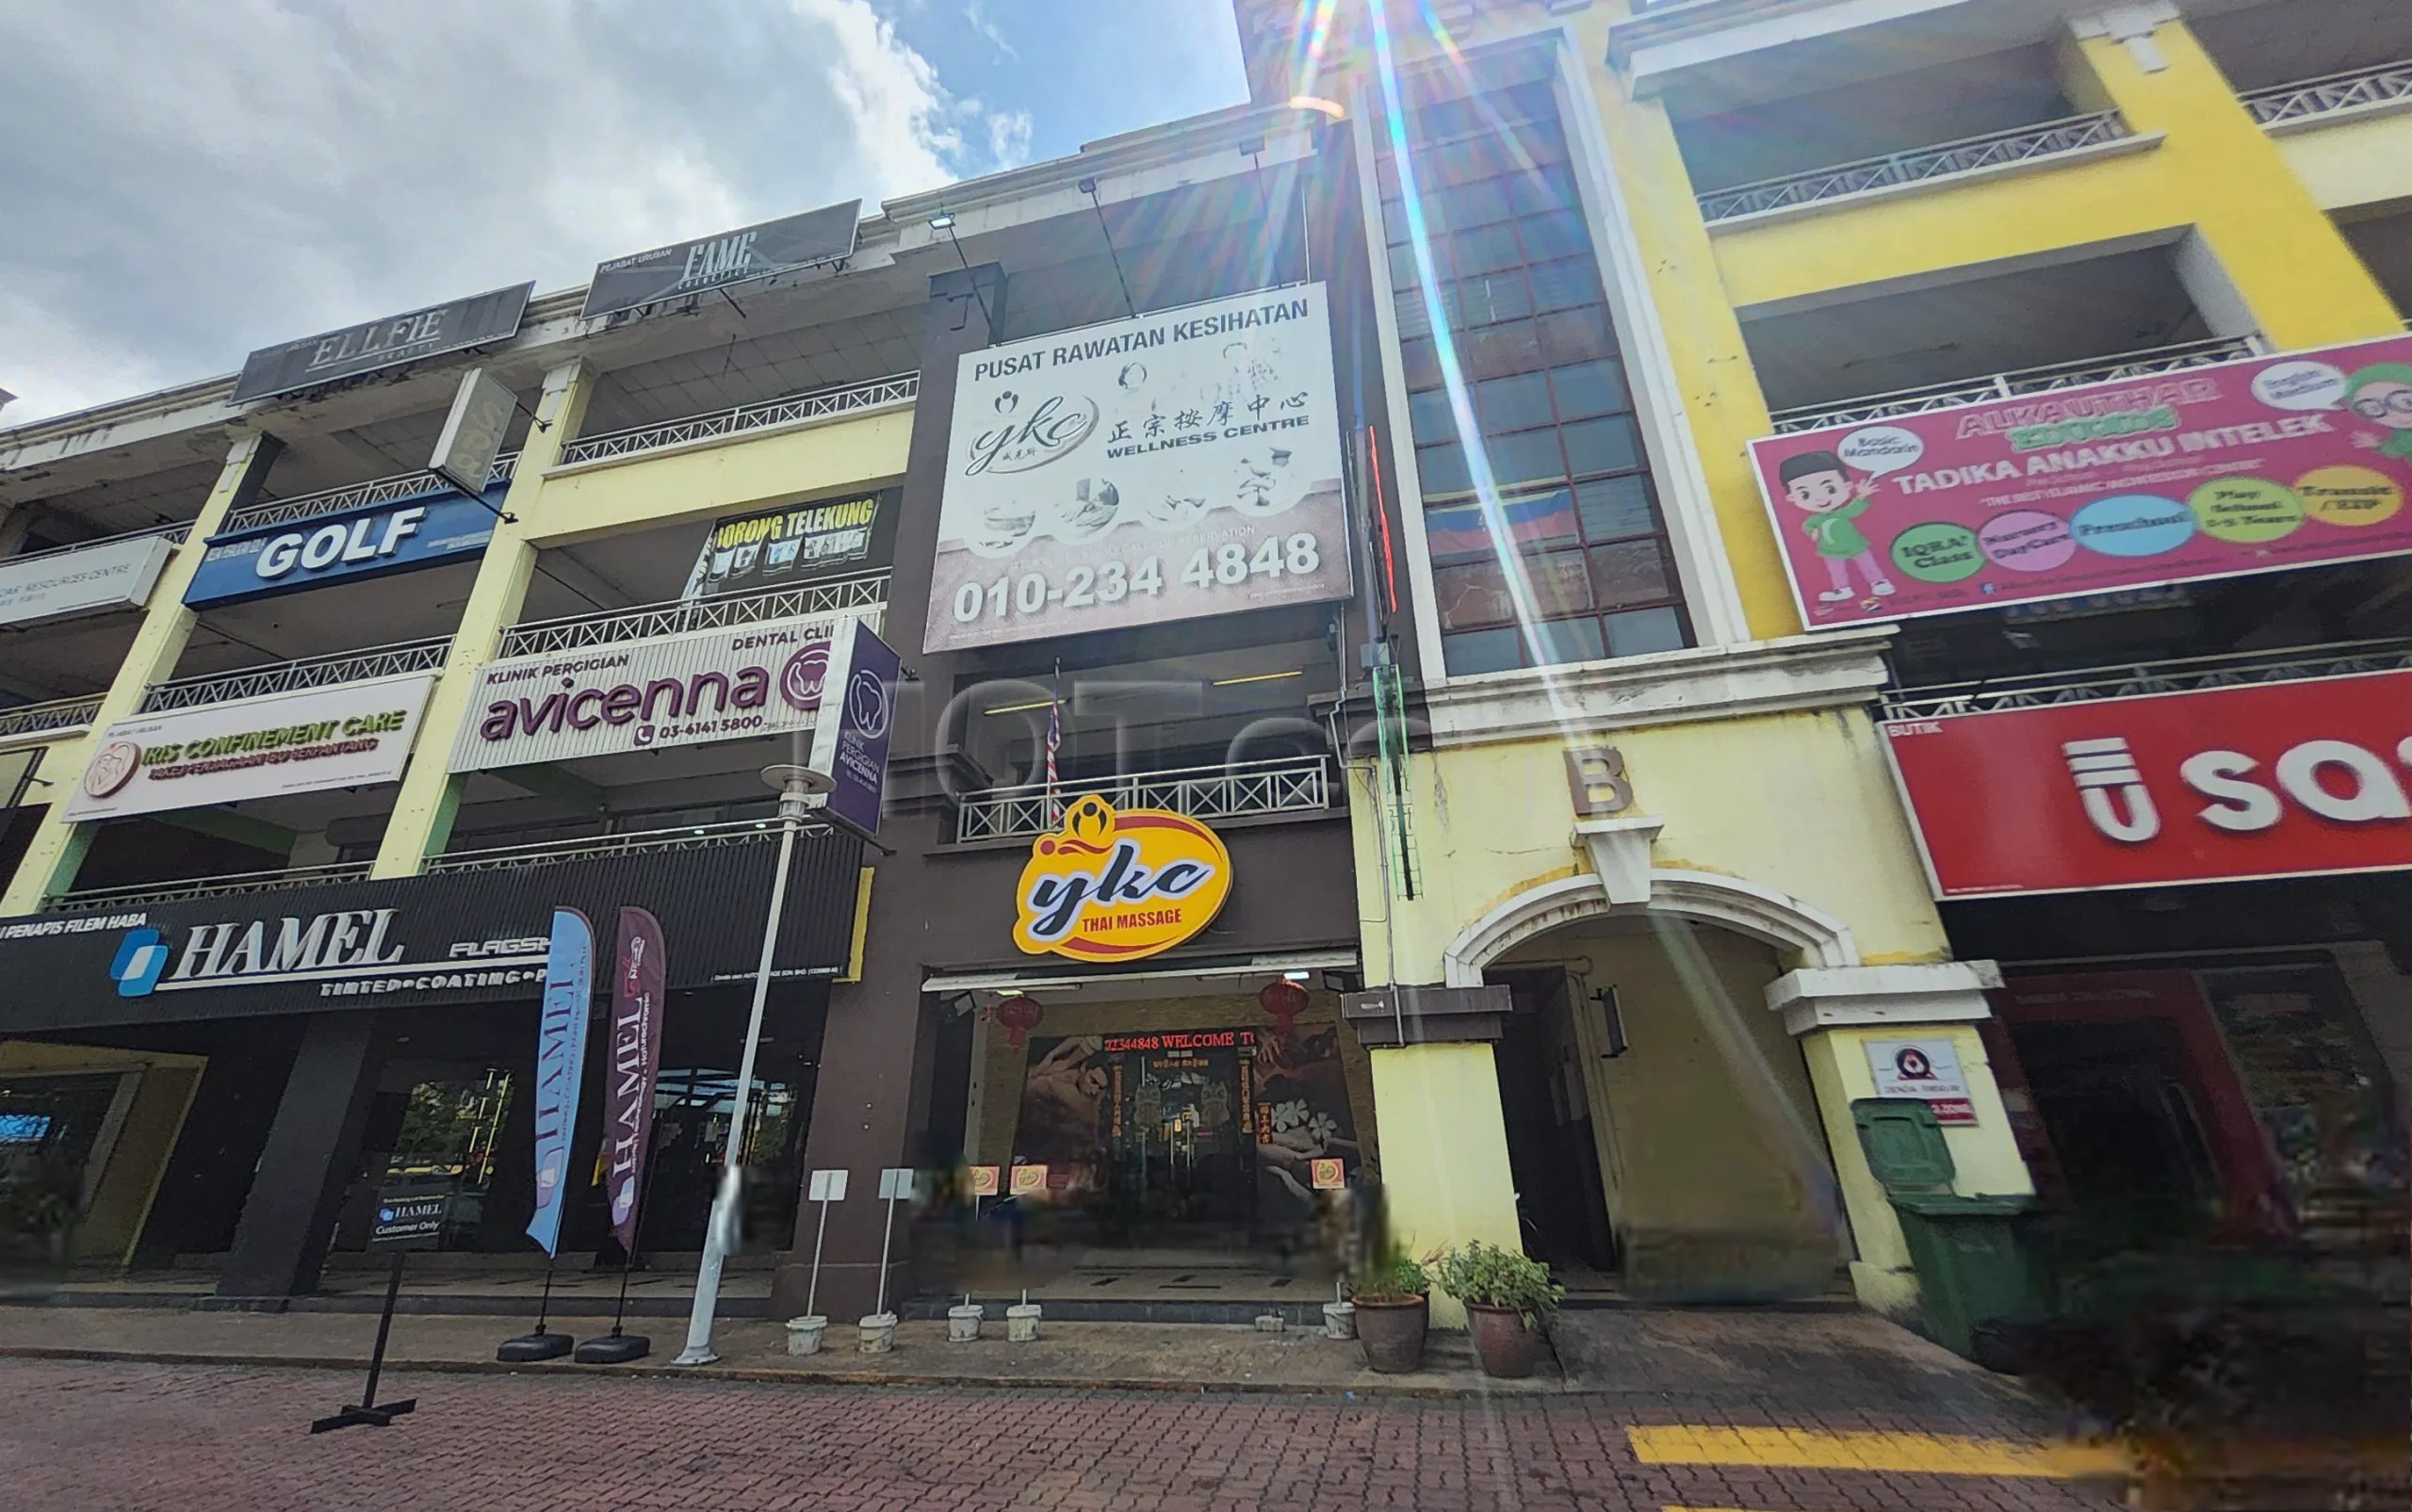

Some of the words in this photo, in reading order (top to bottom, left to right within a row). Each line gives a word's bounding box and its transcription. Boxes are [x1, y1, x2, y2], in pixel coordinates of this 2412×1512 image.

[682, 231, 758, 282] FAME
[309, 309, 449, 366] ELLFIE
[974, 350, 1047, 382] PUSAT
[1051, 326, 1165, 368] RAWATAN
[1173, 299, 1309, 343] KESIHATAN
[1106, 430, 1217, 459] WELLNESS
[1223, 415, 1310, 439] CENTRE
[1107, 390, 1310, 445] 正宗按摩中心
[1892, 458, 2023, 495] TADIKA
[2026, 437, 2176, 473] ANAKKU
[2176, 414, 2335, 452] INTELEK
[786, 498, 874, 538] TELEKUNG
[255, 506, 426, 578] GOLF
[1913, 551, 1974, 569] Class
[953, 555, 1164, 624] 010-234
[1180, 531, 1320, 590] 4848
[732, 630, 799, 652] DENTAL
[485, 665, 540, 687] KLINIK
[543, 653, 630, 676] PERGIGIAN
[479, 665, 771, 743] avicenna
[660, 720, 718, 740] 03-6141
[720, 714, 764, 732] 5800
[184, 719, 341, 761] CONFINEMENT
[341, 709, 408, 738] CARE
[1887, 722, 1944, 738] BUTIK
[839, 750, 878, 785] AVICENNA
[1562, 745, 1635, 817] B
[2179, 736, 2412, 832] sa
[5, 920, 67, 939] PENAPIS
[64, 916, 107, 934] FILEM
[106, 912, 148, 930] HABA
[1083, 916, 1114, 933] THAI
[1116, 907, 1182, 930] MASSAGE
[170, 907, 405, 981] HAMEL
[1161, 1032, 1235, 1049] WELCOME
[611, 996, 644, 1179] HAMEL
[376, 1224, 418, 1235] Customer
[418, 1220, 441, 1231] Only
[396, 1203, 443, 1218] HAMEL
